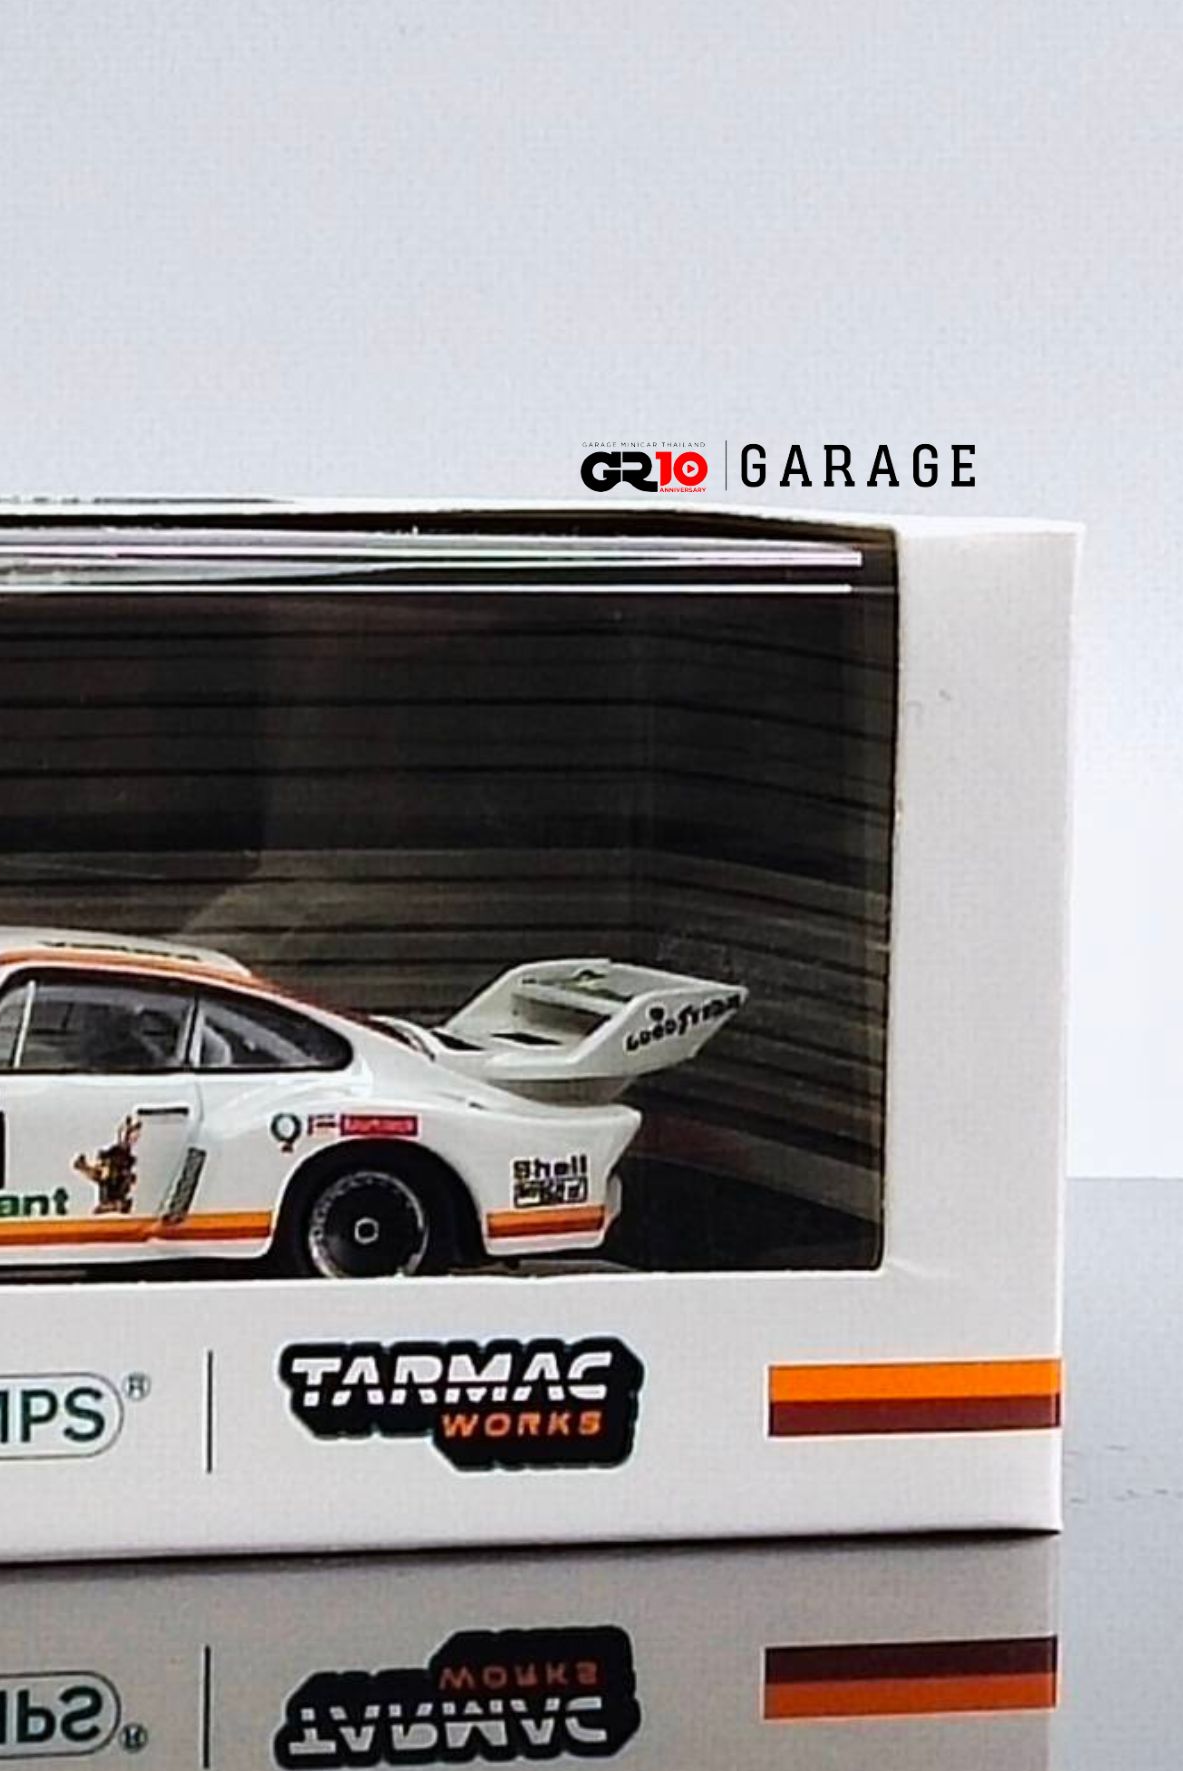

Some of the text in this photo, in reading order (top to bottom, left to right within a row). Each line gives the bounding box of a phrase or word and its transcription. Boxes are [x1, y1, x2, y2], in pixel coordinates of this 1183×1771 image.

[513, 1154, 587, 1179] Shell
[291, 1351, 612, 1407] TARMAC
[441, 1410, 604, 1438] WORKS
